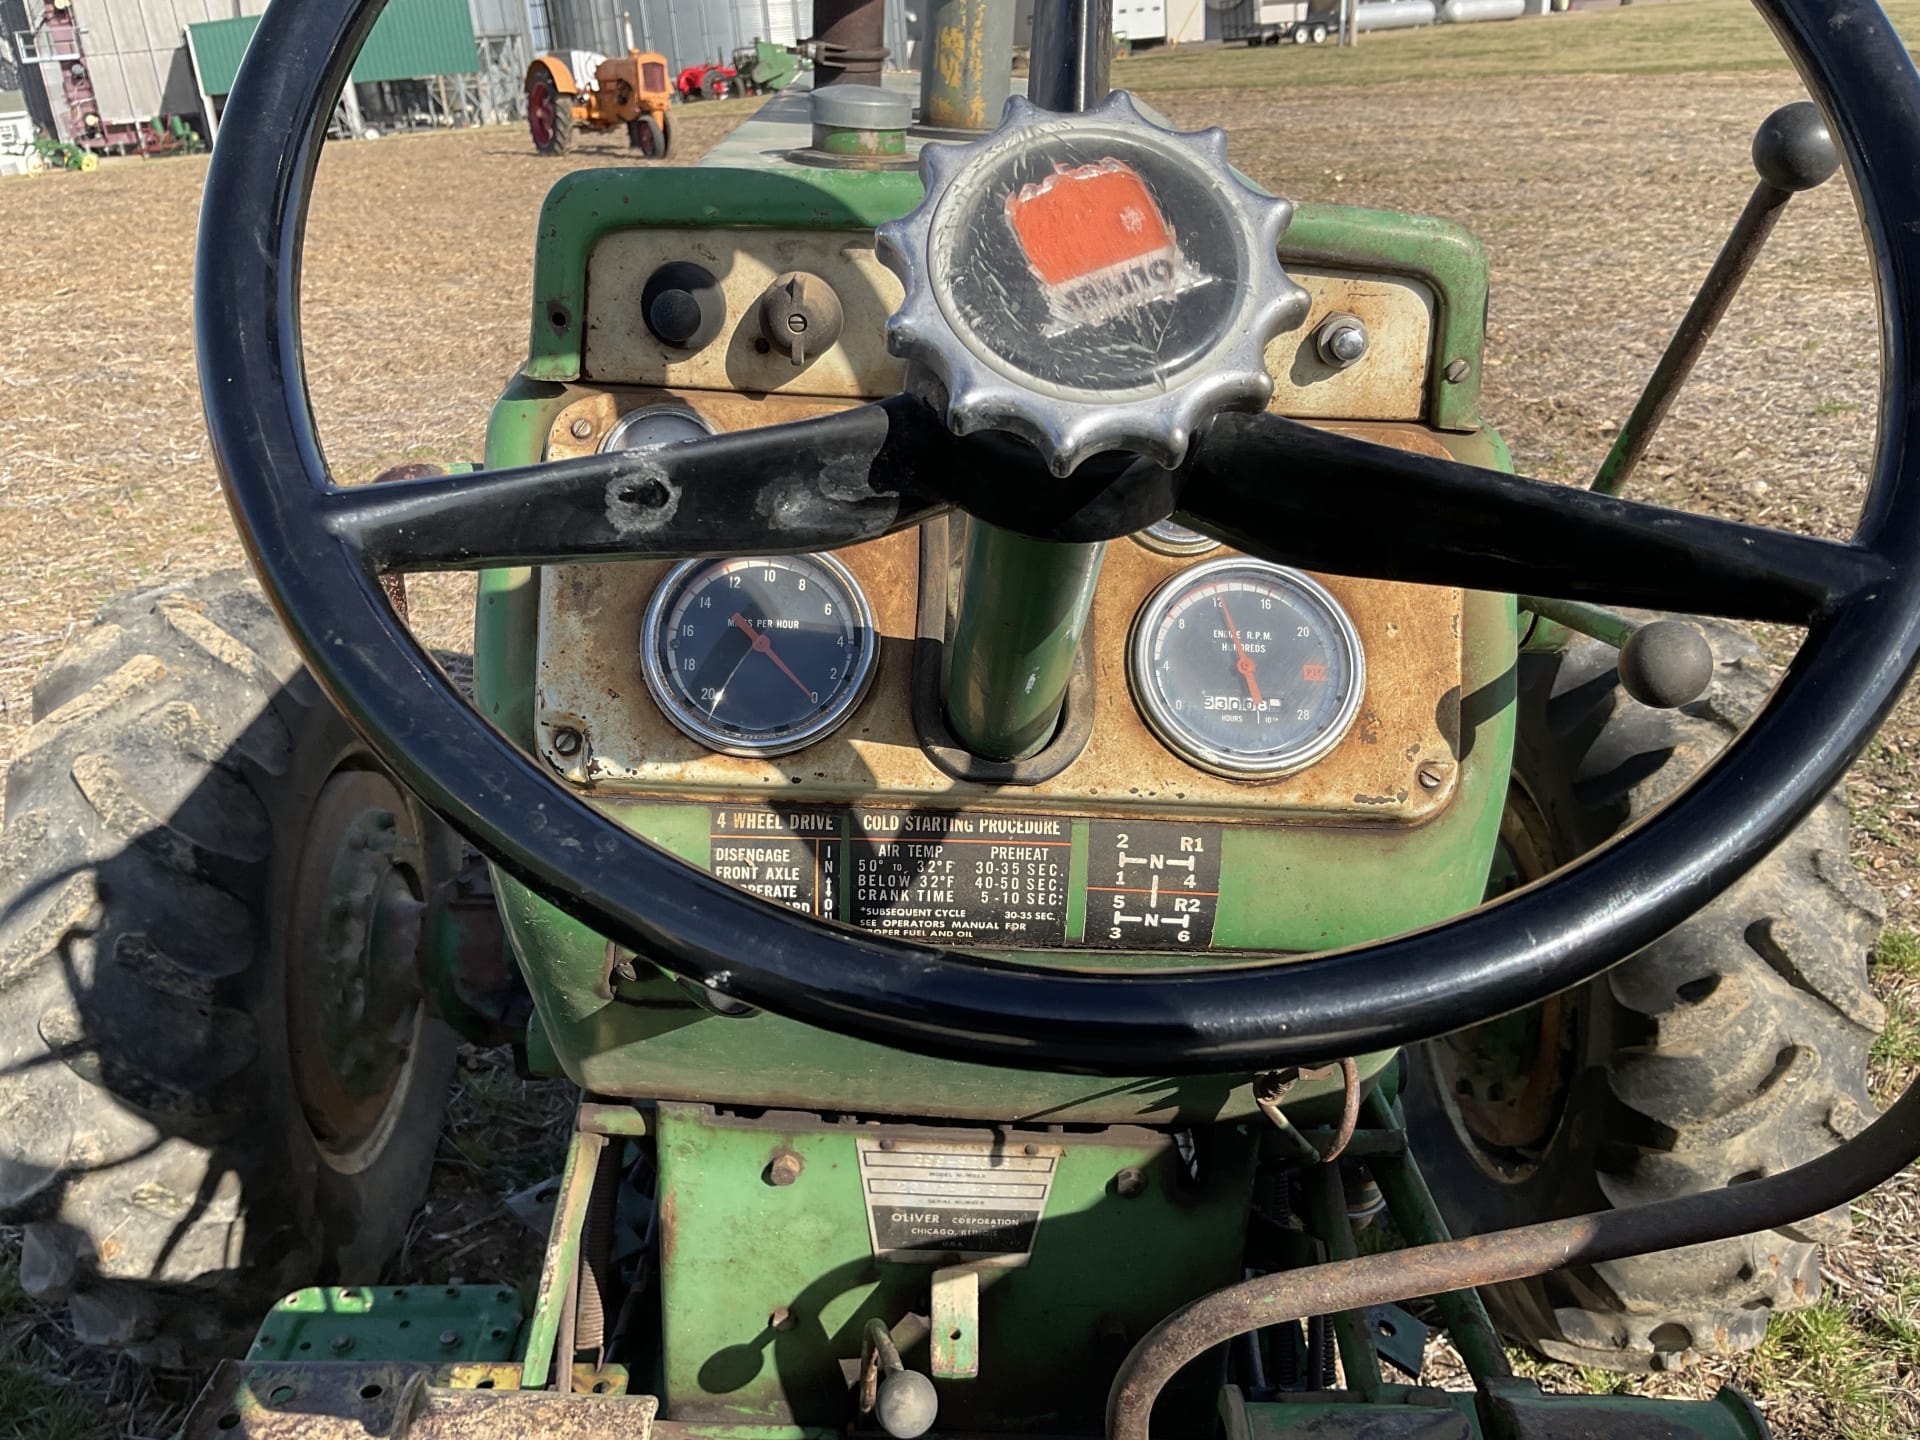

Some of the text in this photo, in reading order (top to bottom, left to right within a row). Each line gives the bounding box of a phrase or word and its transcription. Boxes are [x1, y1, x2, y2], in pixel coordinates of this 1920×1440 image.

[729, 576, 741, 588] 12
[764, 570, 776, 582] 10
[798, 579, 806, 591] 8
[700, 597, 711, 608] 14
[1260, 598, 1272, 610] 16
[824, 603, 832, 616] 6
[682, 624, 694, 636] 16
[757, 619, 773, 628] PER
[776, 619, 800, 629] HOUR
[1178, 619, 1185, 630] 8
[1213, 629, 1273, 641] ENGIE R.P.M.
[1297, 626, 1310, 637] 20
[837, 635, 844, 648] 4
[684, 658, 696, 670] 18
[1163, 661, 1169, 671] 4
[830, 668, 837, 680] 2
[701, 687, 716, 700] 20
[811, 692, 818, 704] 0
[1175, 700, 1182, 711] 0
[1222, 715, 1243, 723] HOURS
[1297, 710, 1310, 721] 28
[717, 812, 834, 830] 4 WHEEL DRIVE
[863, 814, 1061, 835] COLD STARTING PROCEDURE
[1116, 833, 1204, 852] 2 R1
[716, 848, 791, 862] DISENGAGE
[878, 844, 1048, 861] AIR TEMP PREHEAT
[1149, 854, 1164, 869] N
[716, 866, 800, 880] FRONT AXLE
[975, 861, 1020, 875] 30-35
[1027, 863, 1064, 877] SEC.
[858, 874, 911, 887] BELOW
[975, 876, 1020, 890] 40-50
[1026, 878, 1063, 891] SEC.
[1115, 871, 1197, 888] 1 4
[858, 888, 910, 902] CRANK
[917, 889, 954, 903] TIME
[1112, 895, 1201, 913] 5 R2
[934, 908, 966, 918] CYCLE
[1004, 911, 1032, 920] 30-35
[1035, 912, 1056, 921] SEC.
[1144, 914, 1159, 927] N
[860, 919, 1026, 931] SEE OPERATORS MANUAL FOR
[866, 928, 974, 938] ROPER FUEL AND OIL
[1109, 927, 1191, 942] 3 6
[891, 1213, 1020, 1226] OLIVER CORPORATION
[911, 1227, 957, 1236] CHICAGO,
